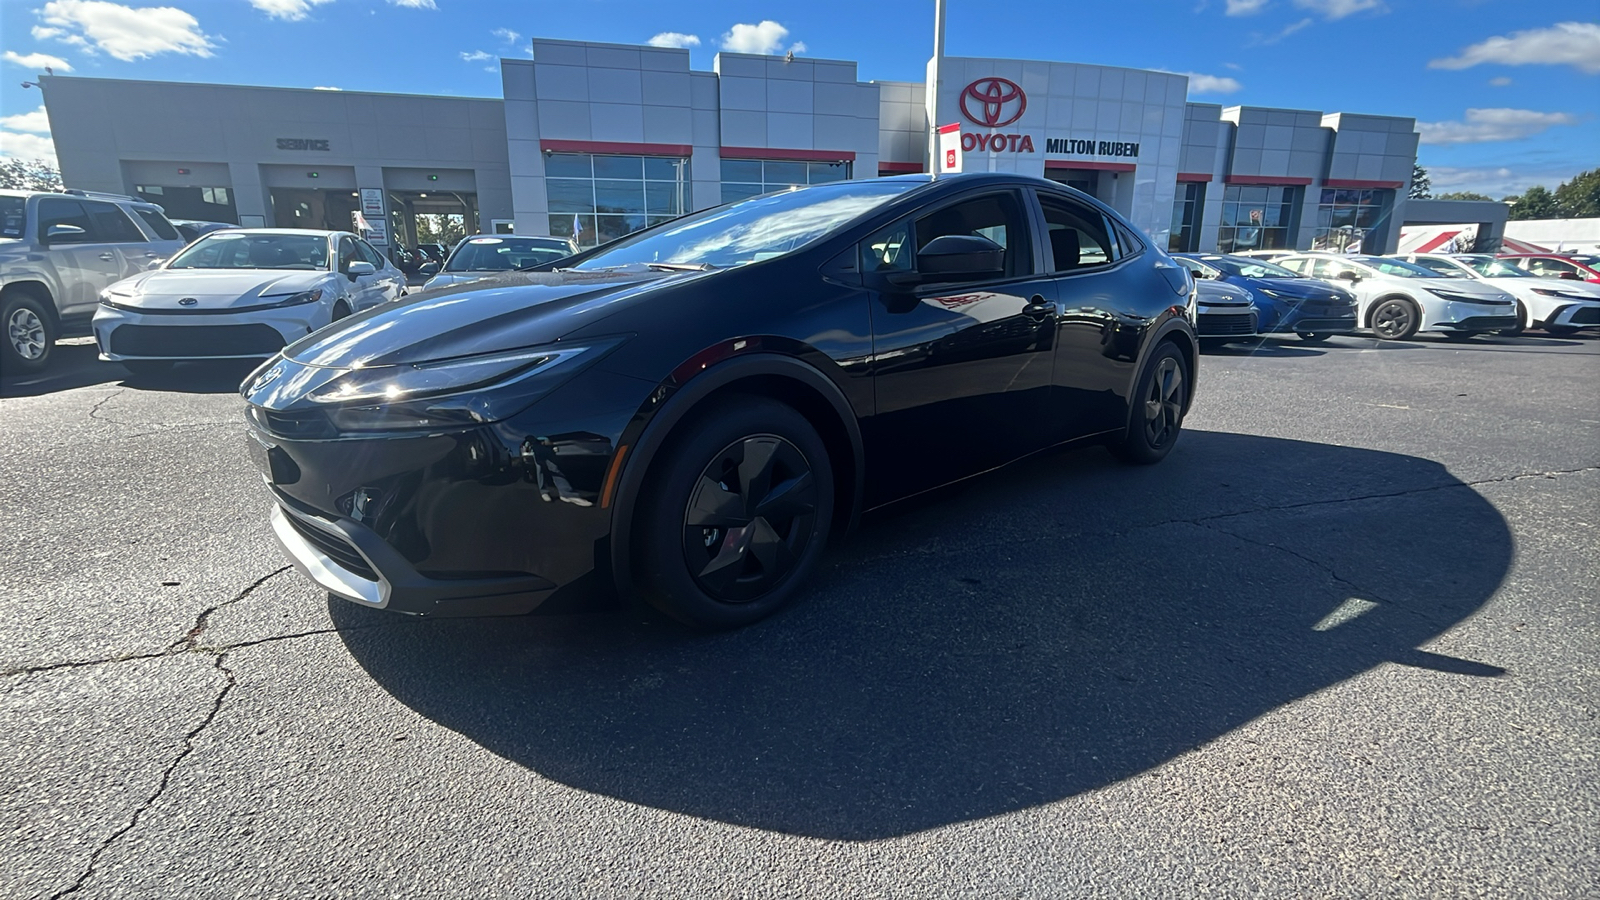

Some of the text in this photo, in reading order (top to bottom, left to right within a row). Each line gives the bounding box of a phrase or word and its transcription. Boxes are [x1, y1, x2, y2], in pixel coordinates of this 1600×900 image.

[276, 138, 330, 151] SERVICE
[961, 132, 1034, 152] OYOTA
[1046, 138, 1139, 157] MILTON RUBEN
